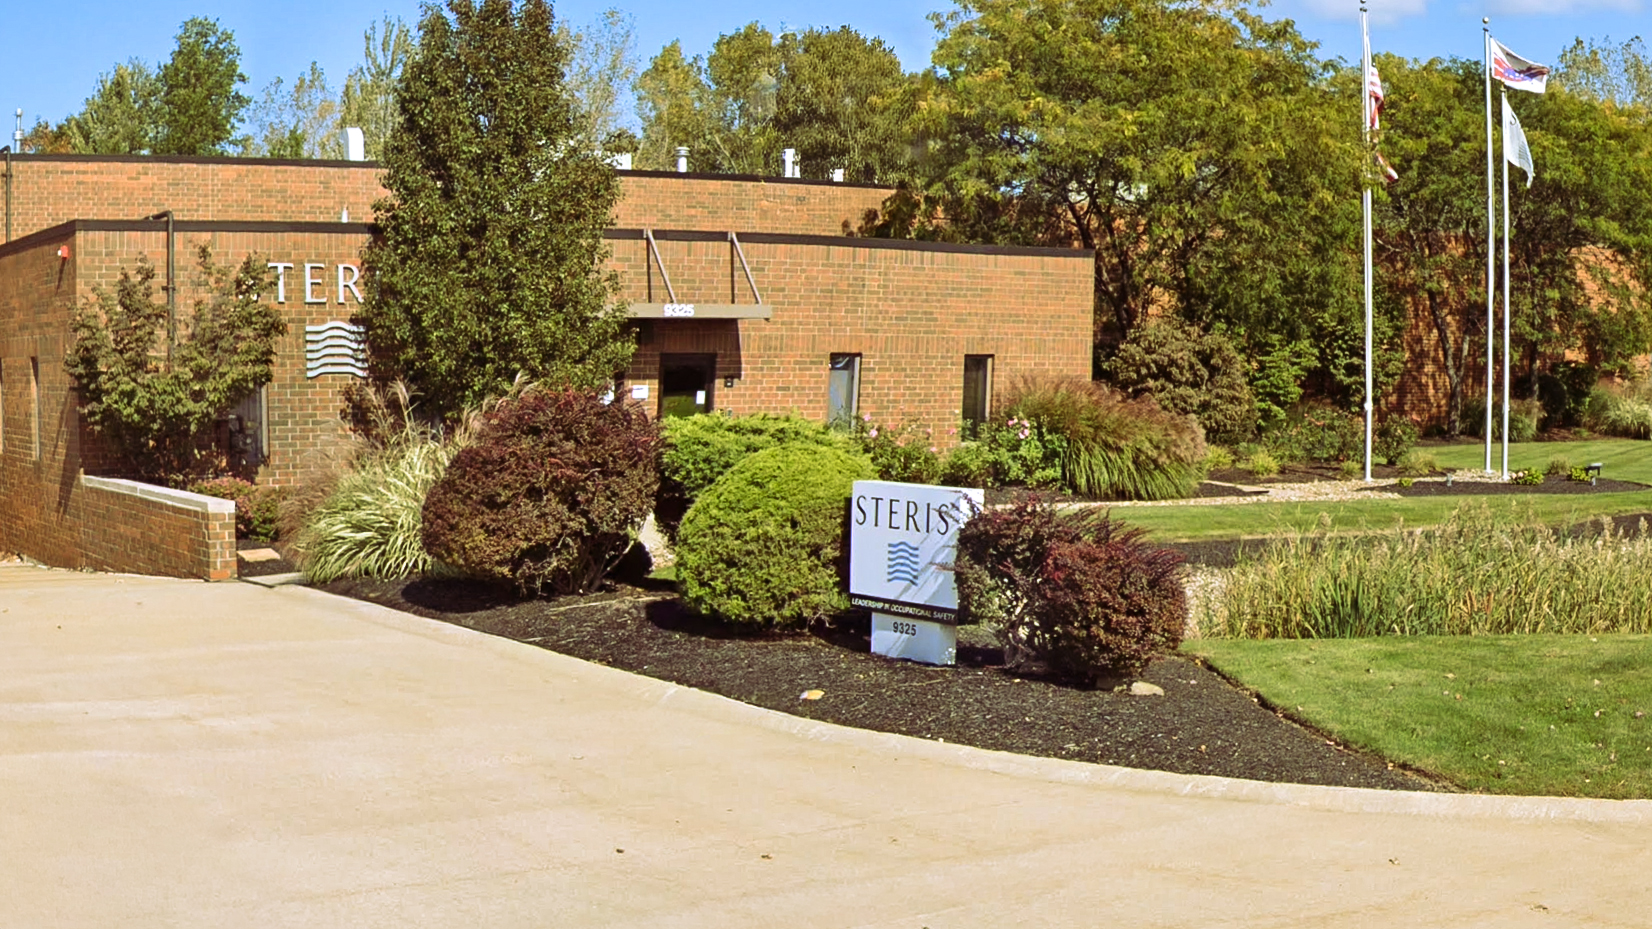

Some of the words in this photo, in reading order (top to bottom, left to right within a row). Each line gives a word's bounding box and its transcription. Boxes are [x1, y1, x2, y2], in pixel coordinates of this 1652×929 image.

[238, 262, 369, 304] TER
[664, 304, 695, 317] 9325
[855, 495, 949, 535] STERIS
[851, 598, 884, 609] LEADERSHIP
[891, 604, 932, 617] OCCUPATIONAL
[932, 612, 956, 620] SAFETY
[893, 621, 917, 636] 9325
